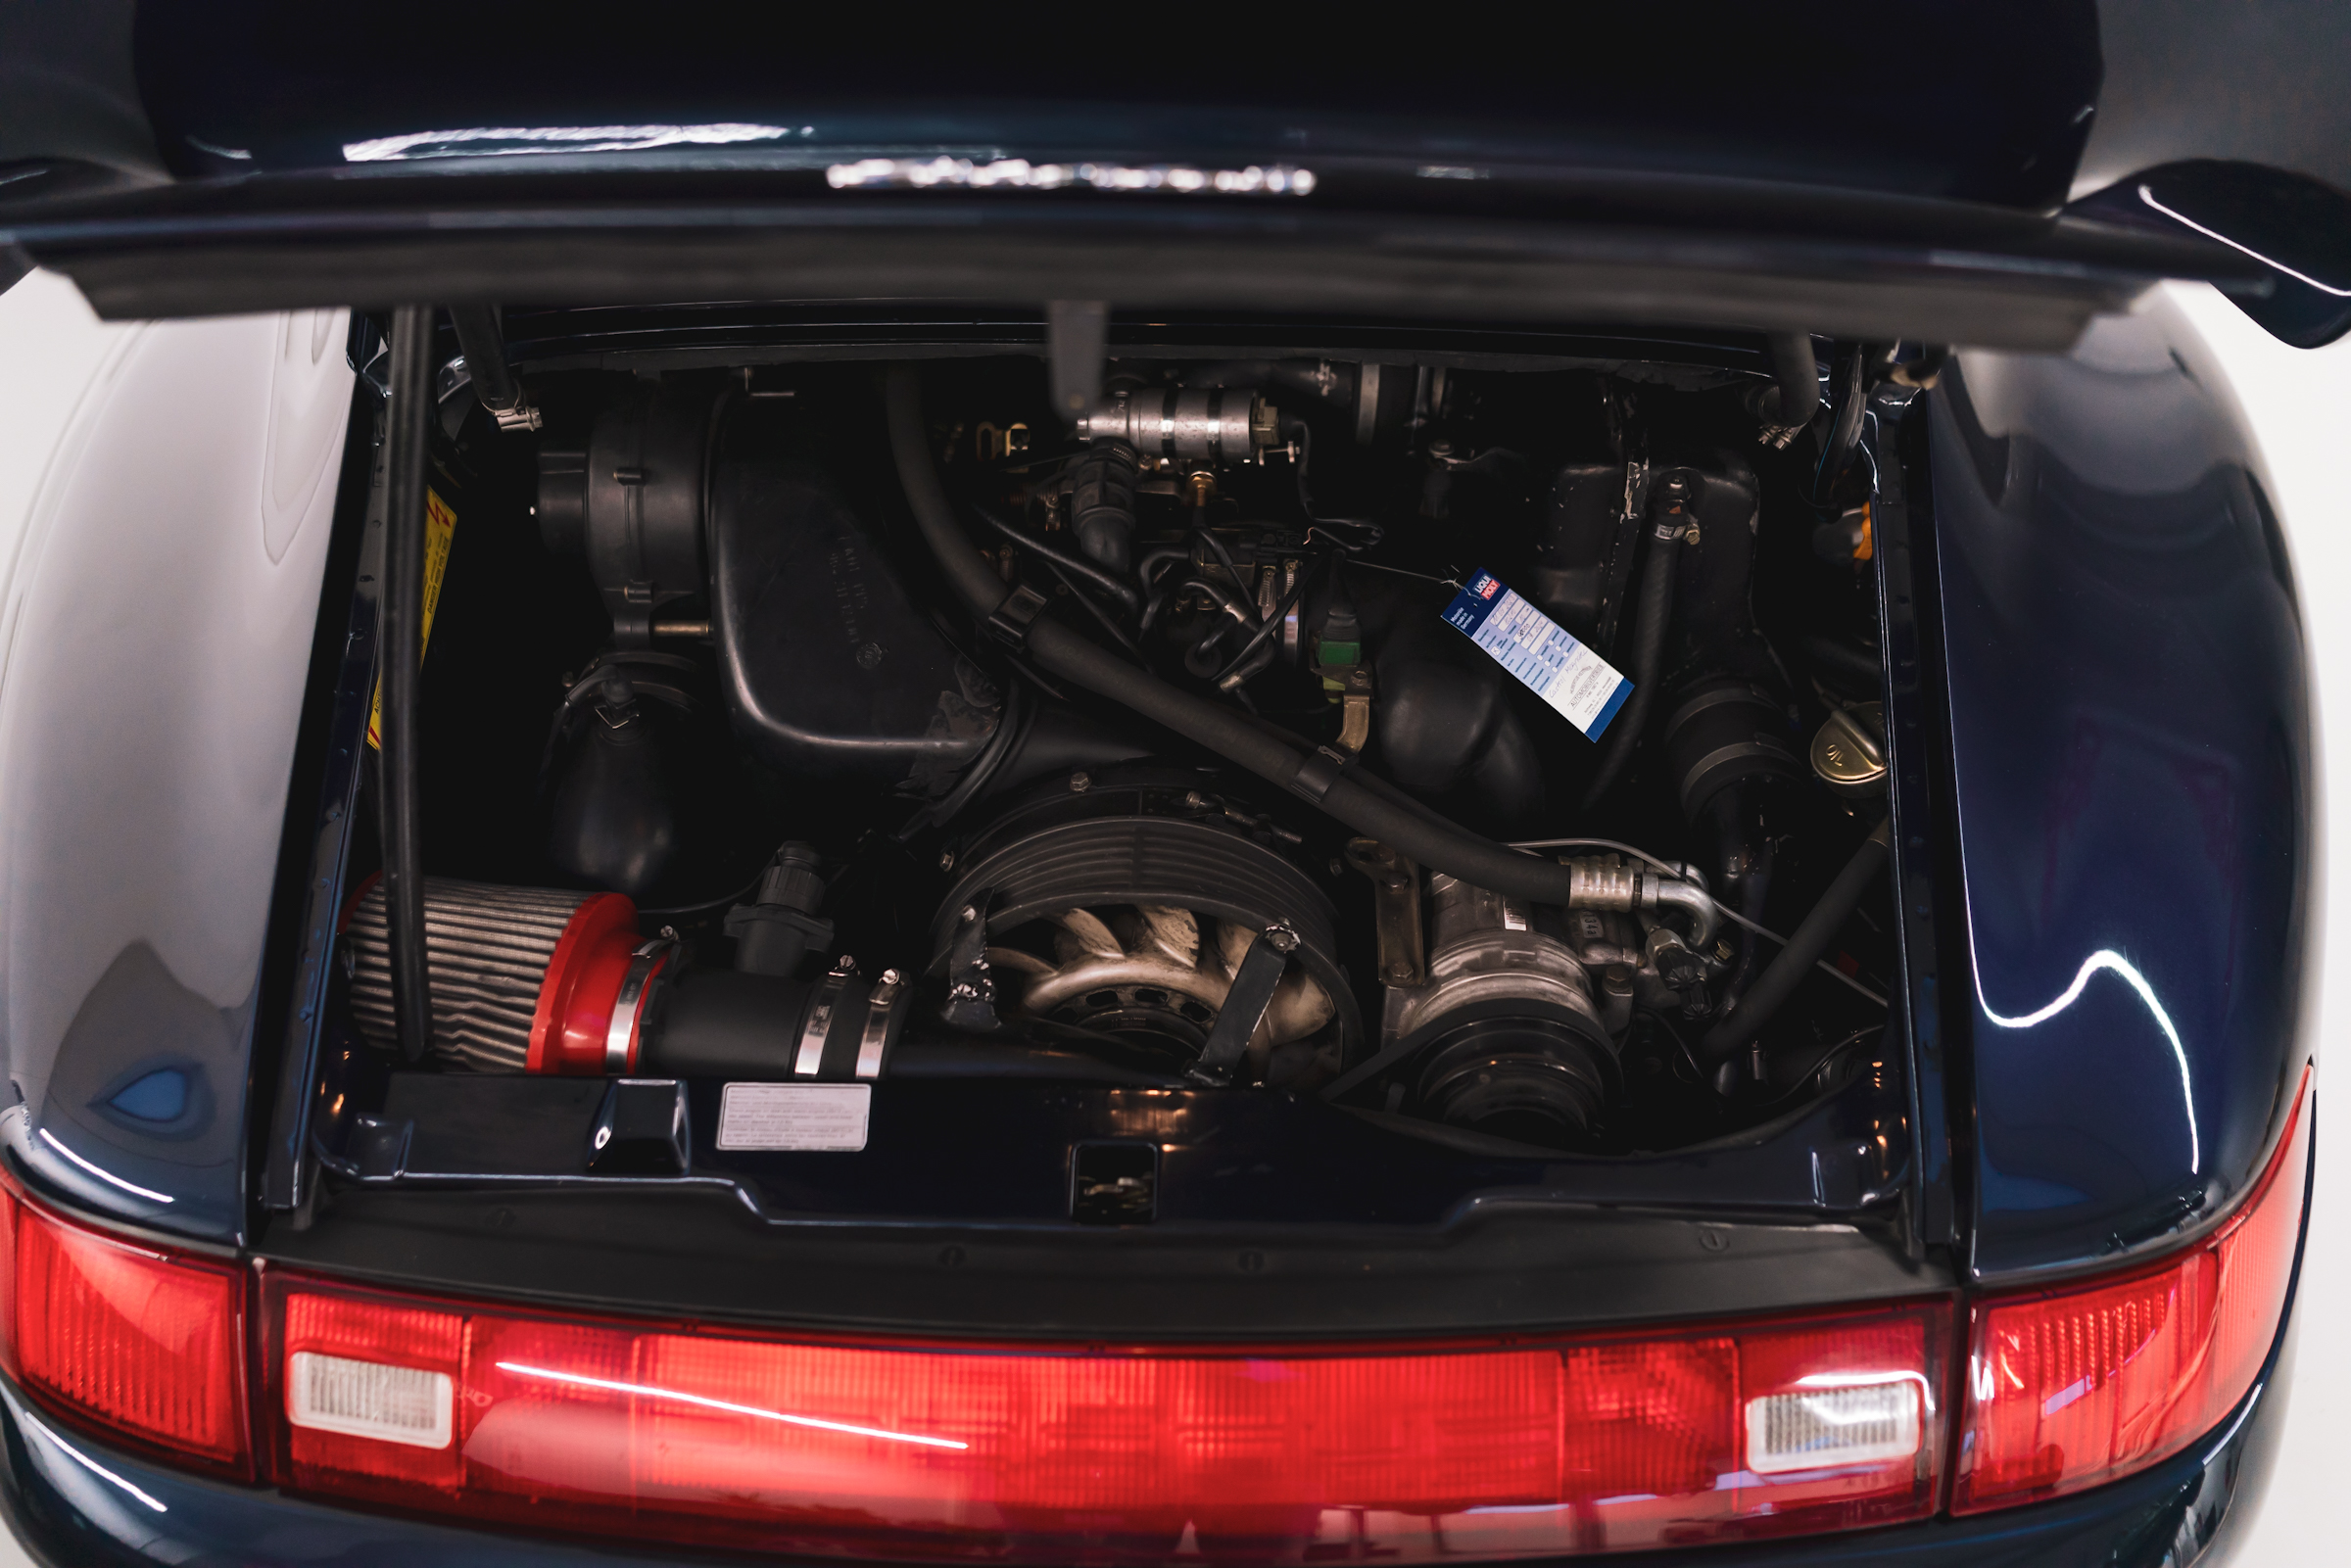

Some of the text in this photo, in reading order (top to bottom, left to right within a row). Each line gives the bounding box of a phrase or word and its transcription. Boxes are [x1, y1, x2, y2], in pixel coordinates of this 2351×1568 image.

[1474, 574, 1491, 594] LIQUI
[1481, 580, 1499, 599] MOLY
[426, 585, 437, 613] DANGER
[1456, 615, 1464, 626] made
[1460, 613, 1474, 629] Germany
[1546, 675, 1567, 698] Castrol
[1569, 663, 1604, 707] AUTOMOBILVERTRIEB
[1826, 743, 1843, 766] OIL
